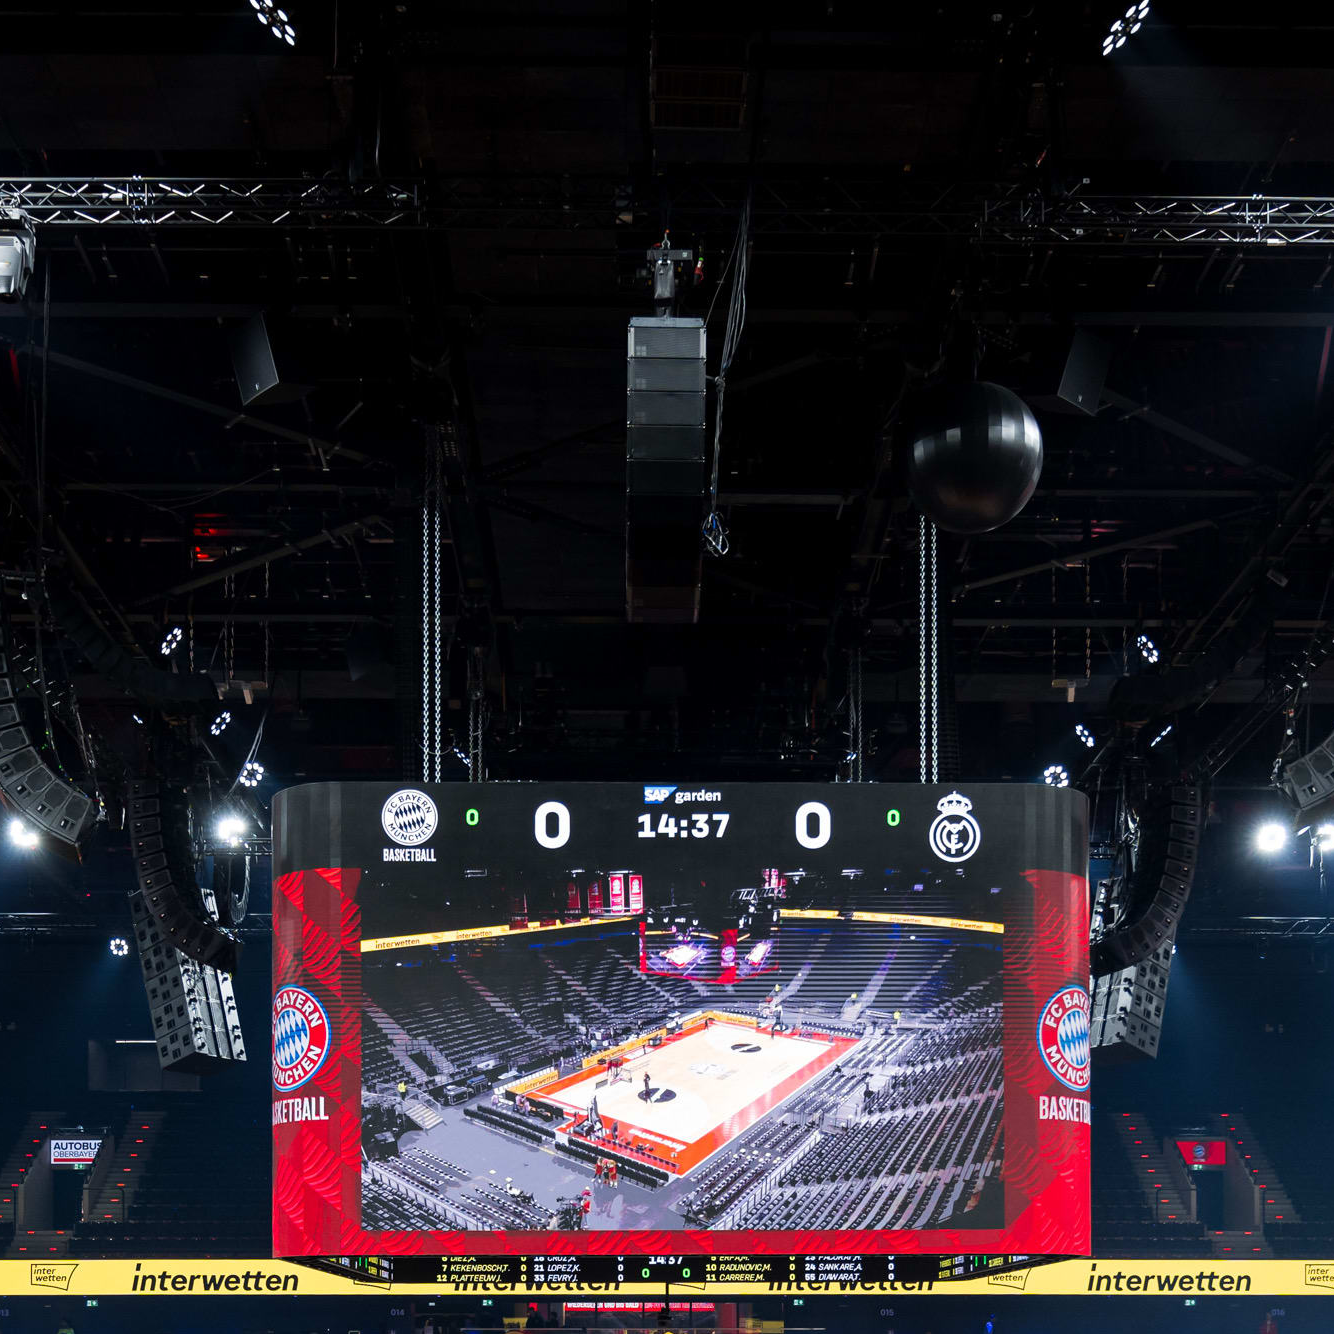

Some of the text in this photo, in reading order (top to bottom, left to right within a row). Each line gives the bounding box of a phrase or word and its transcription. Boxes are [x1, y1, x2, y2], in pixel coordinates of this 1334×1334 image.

[645, 787, 722, 804] SAP garden
[399, 794, 432, 814] BAYERN
[466, 808, 479, 826] 0
[887, 809, 900, 827] 0
[535, 801, 571, 849] 0
[638, 814, 729, 838] 14:37
[795, 801, 831, 849] 0
[383, 849, 436, 862] BASKETBALL
[375, 939, 421, 950] interwetten
[276, 992, 323, 1028] BAYERN
[1045, 1003, 1062, 1028] FC
[33, 1265, 59, 1276] inter
[642, 1268, 650, 1278] 0
[682, 1268, 690, 1278] 0
[789, 1263, 795, 1271] 0
[805, 1263, 895, 1271] 24 0
[1306, 1264, 1331, 1275] inter
[35, 1273, 70, 1285] wetten
[131, 1263, 299, 1292] interwetten
[534, 1274, 624, 1282] 33 0
[789, 1273, 795, 1281] 0
[805, 1273, 895, 1281] 55 0
[1087, 1263, 1252, 1292] interwetten
[390, 1308, 405, 1316] 014
[880, 1308, 895, 1316] 015
